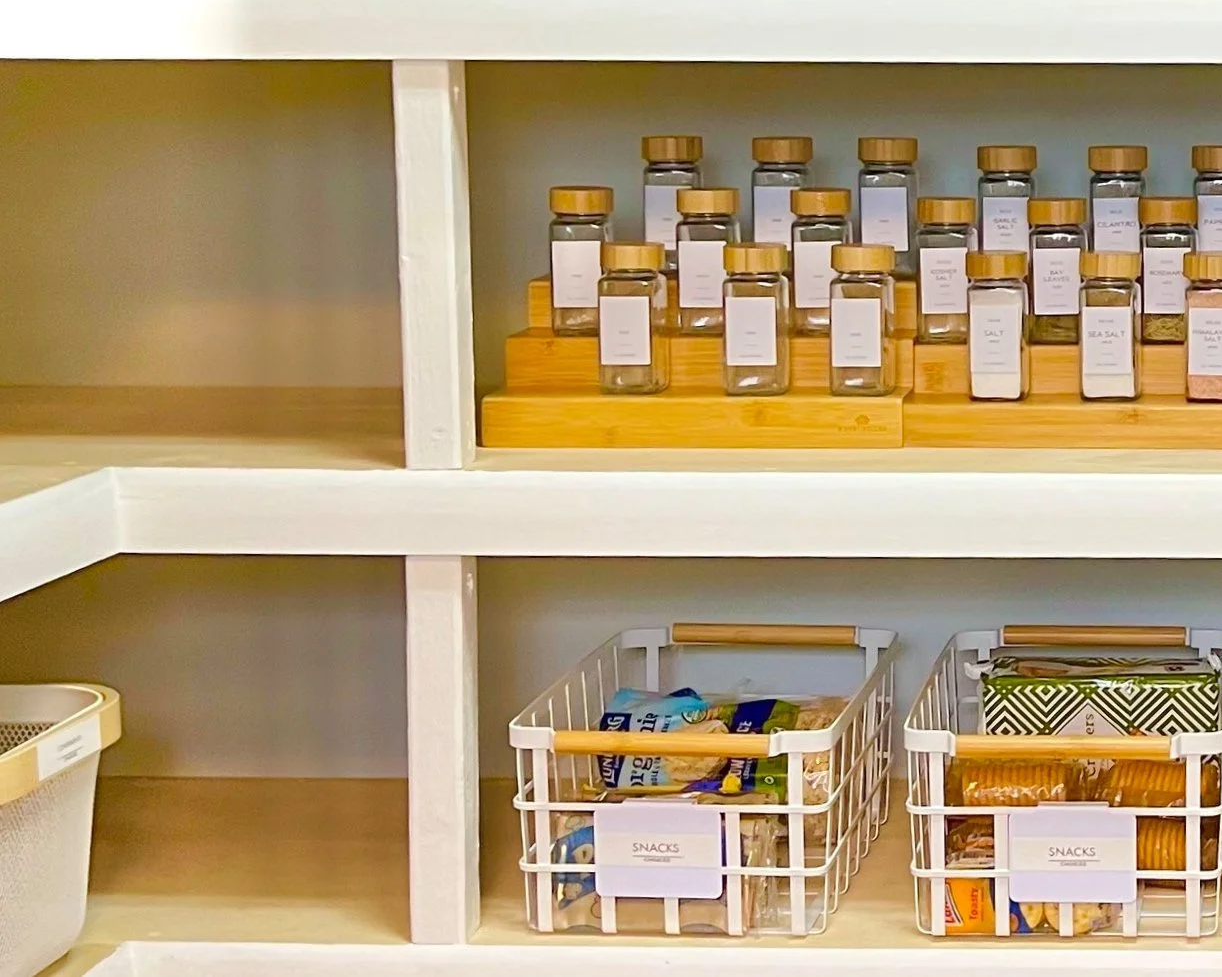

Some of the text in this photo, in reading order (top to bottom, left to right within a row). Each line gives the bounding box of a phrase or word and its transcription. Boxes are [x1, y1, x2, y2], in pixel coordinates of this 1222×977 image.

[1096, 220, 1138, 229] CILANTRO
[983, 329, 1005, 337] SALT
[1087, 329, 1126, 339] SEA SALT
[632, 841, 681, 854] SNACKS
[1048, 846, 1097, 857] SNACKS
[968, 886, 981, 922] Toasty
